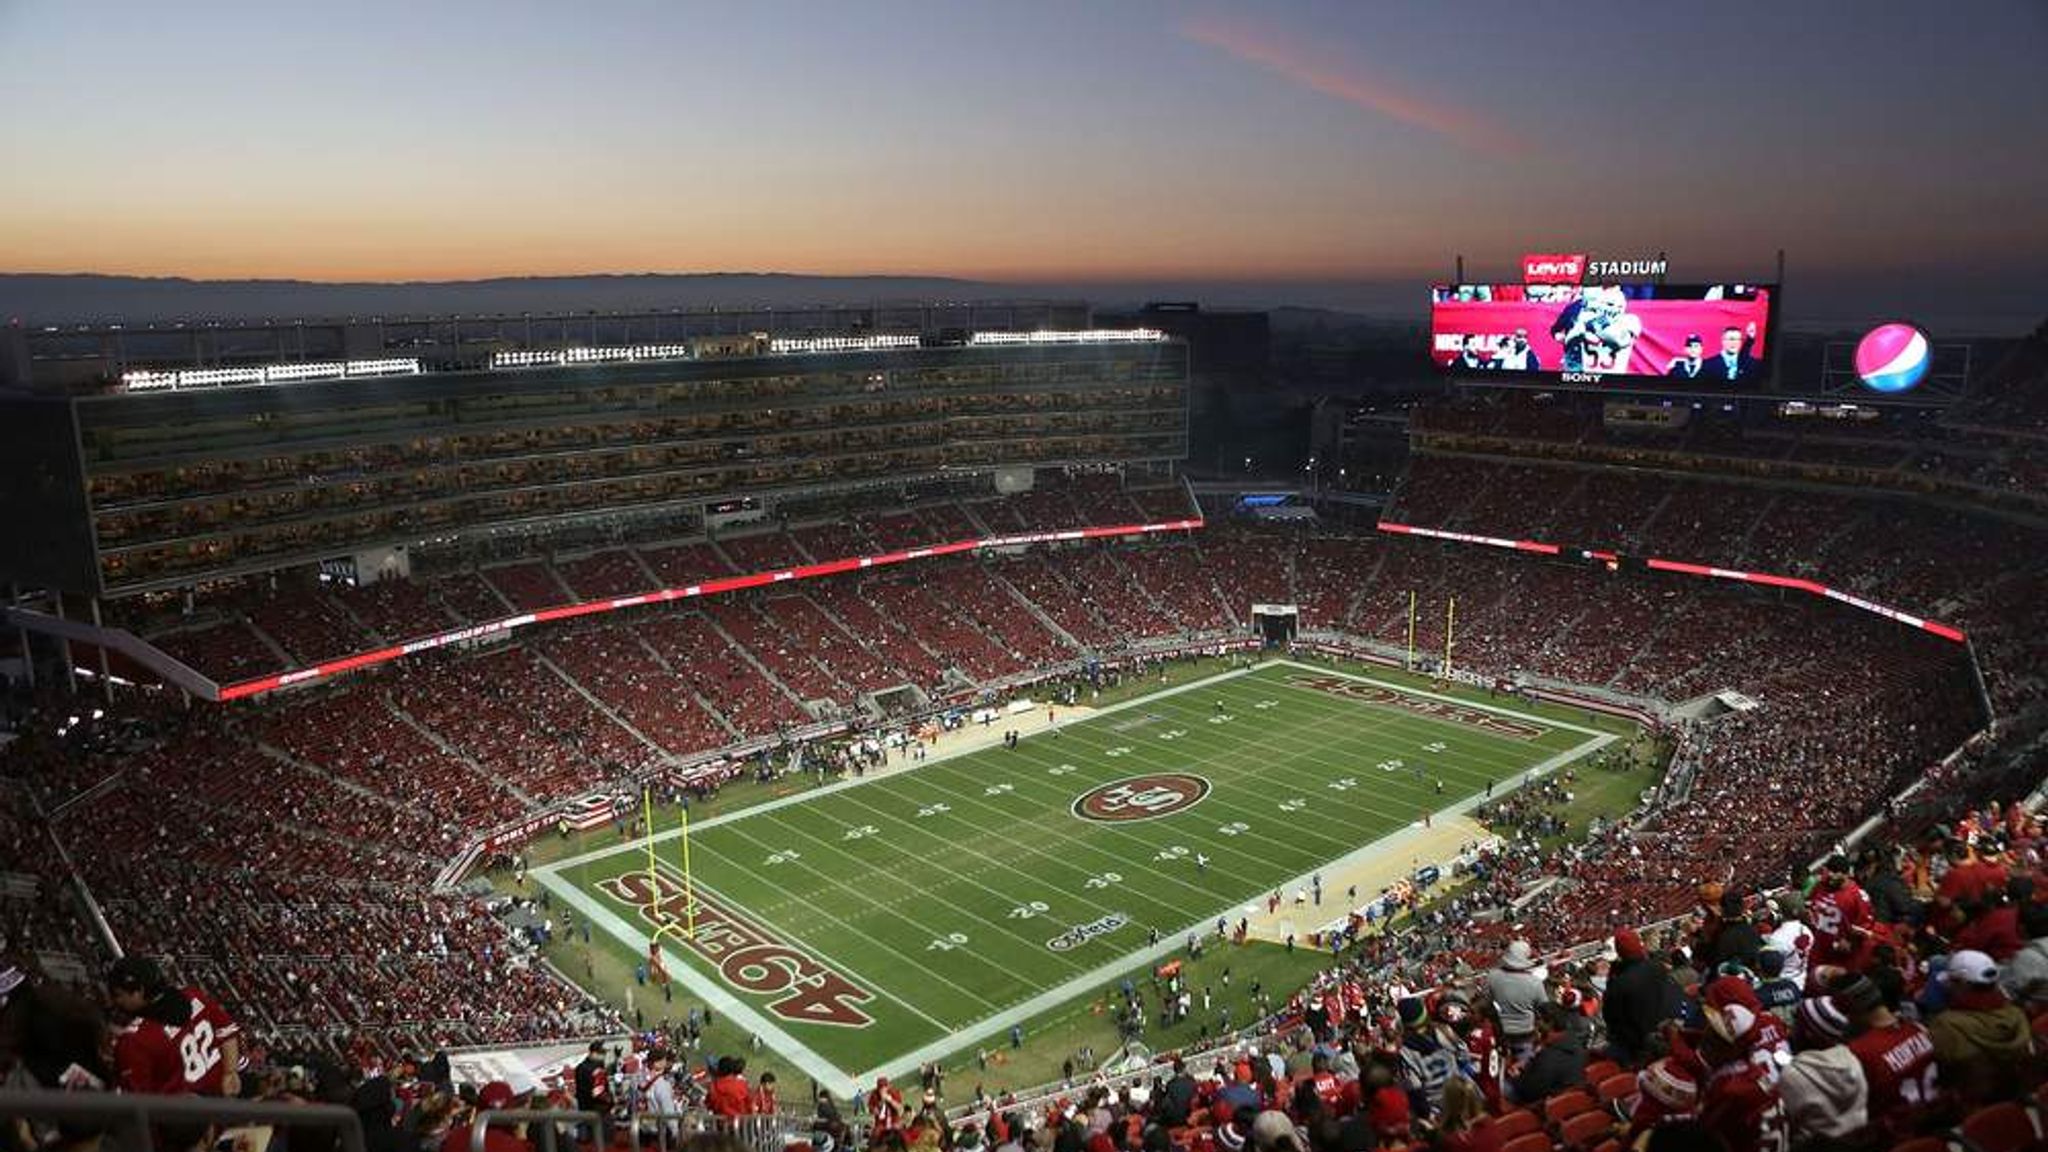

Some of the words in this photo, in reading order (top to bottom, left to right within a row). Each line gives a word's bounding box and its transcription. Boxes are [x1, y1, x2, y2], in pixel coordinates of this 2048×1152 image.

[1589, 261, 1667, 275] STADIUM
[1562, 372, 1602, 382] SONY
[1011, 900, 1050, 919] 20
[181, 1019, 222, 1083] 82
